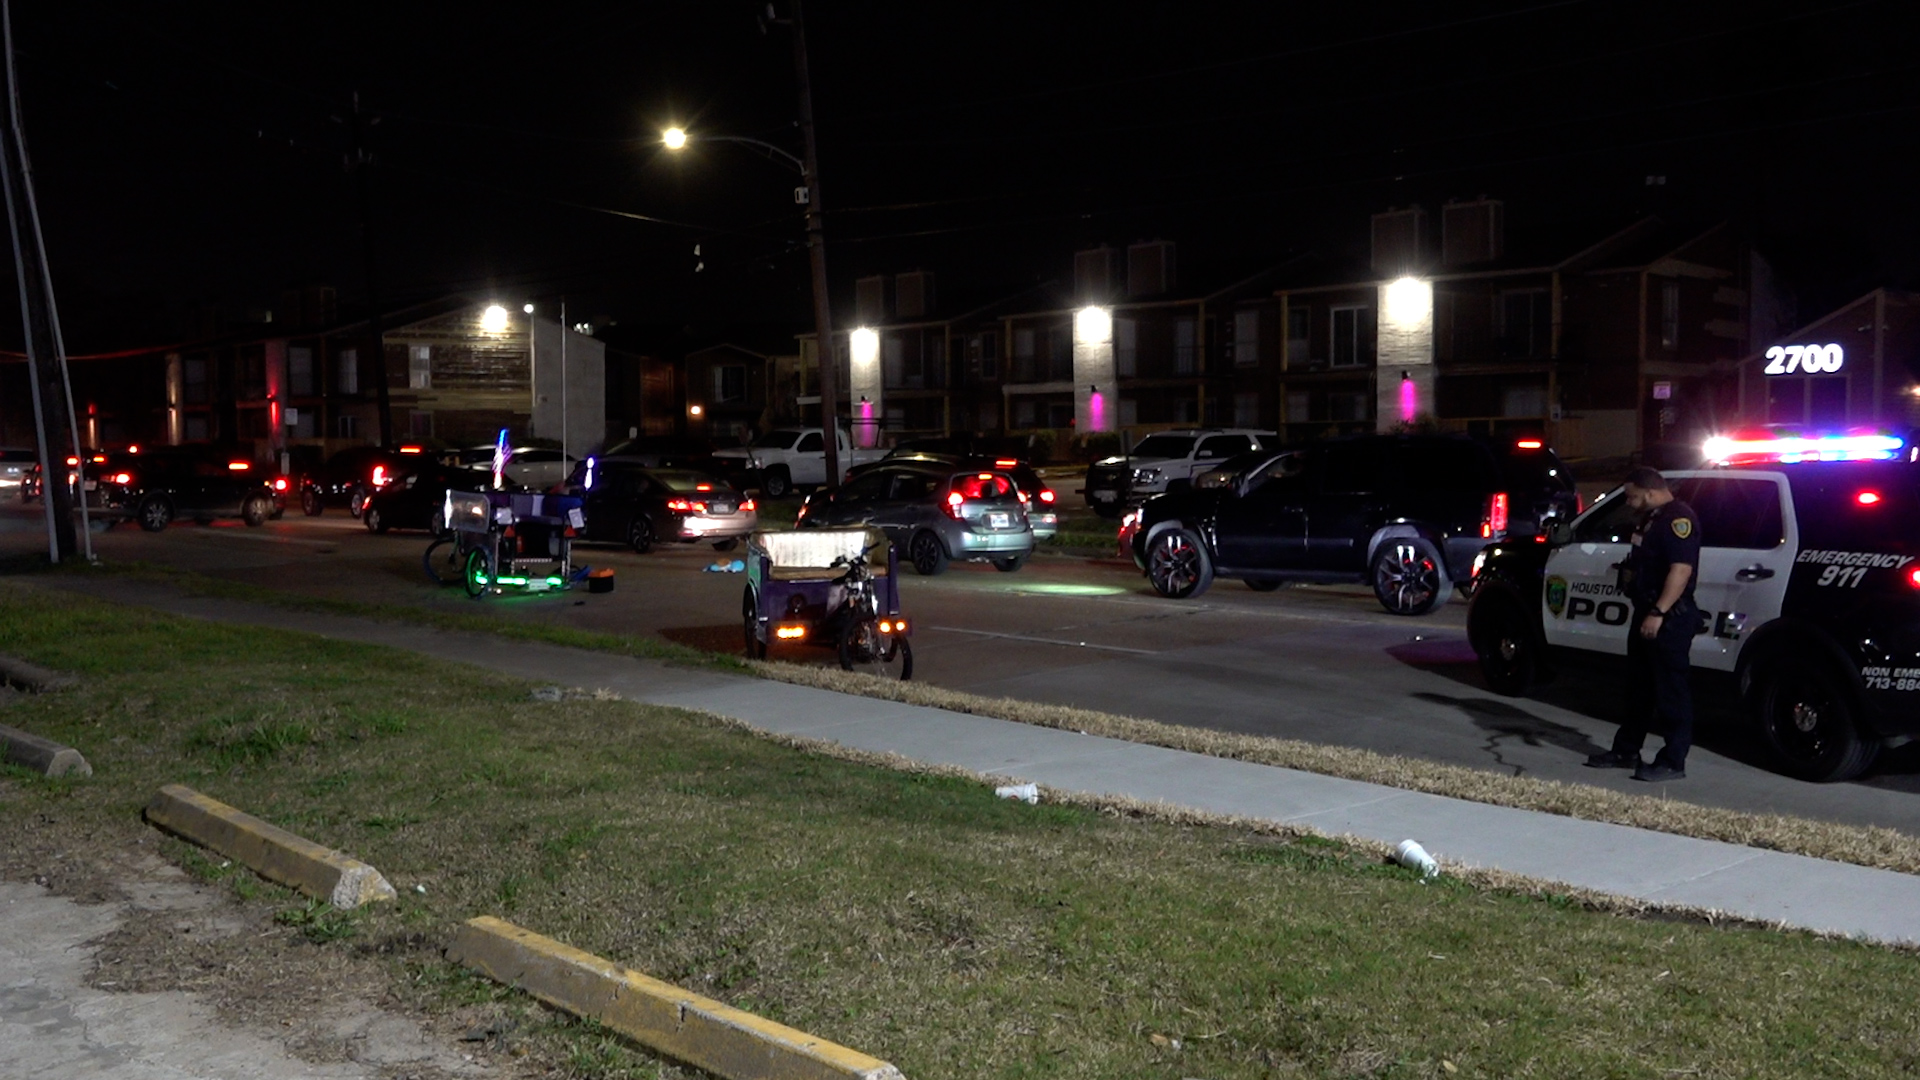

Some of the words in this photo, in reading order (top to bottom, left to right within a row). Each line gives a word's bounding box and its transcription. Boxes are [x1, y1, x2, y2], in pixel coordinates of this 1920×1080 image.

[1764, 343, 1844, 374] 2700
[1796, 549, 1915, 569] EMERGENCY
[1817, 565, 1868, 588] 911
[1861, 666, 1891, 677] NON
